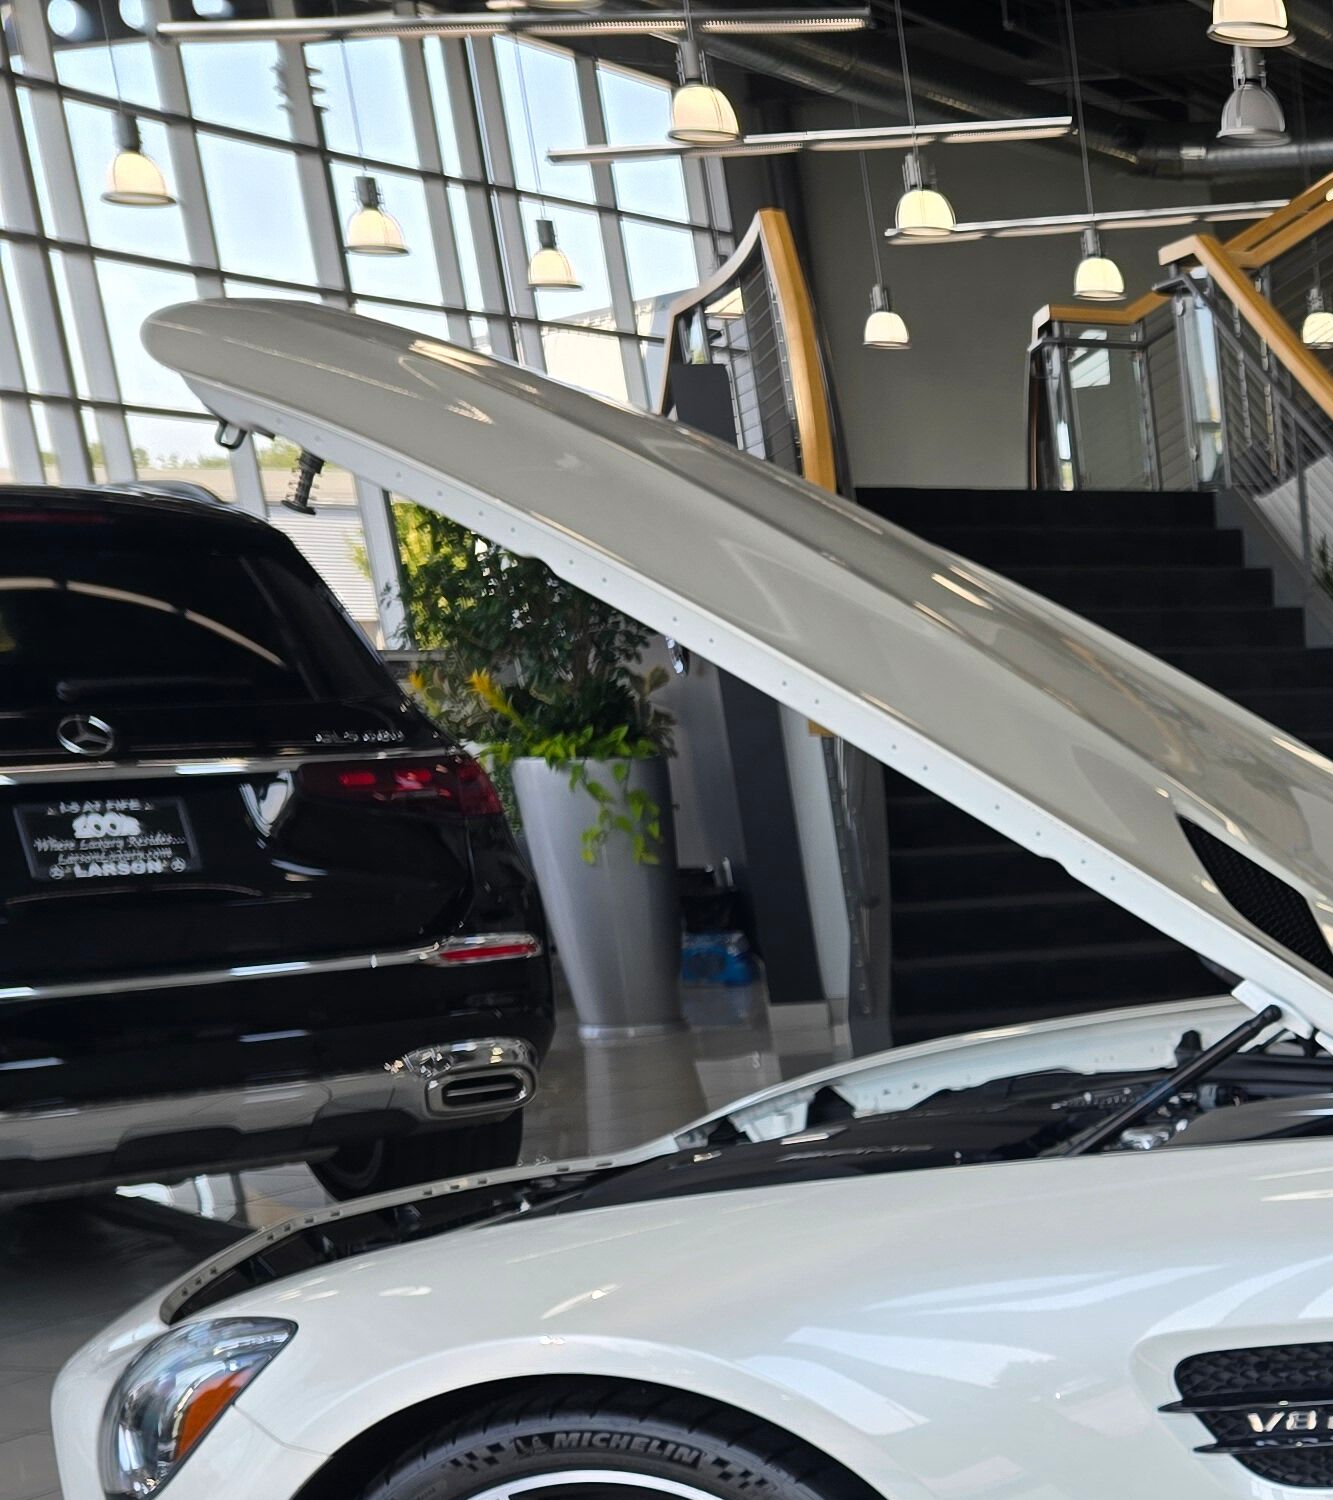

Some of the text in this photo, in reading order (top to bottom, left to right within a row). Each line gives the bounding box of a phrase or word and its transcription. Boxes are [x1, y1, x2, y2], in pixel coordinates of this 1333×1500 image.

[74, 859, 164, 879] LARSON
[1247, 1410, 1318, 1432] V8
[552, 1431, 700, 1464] MICHELIN
